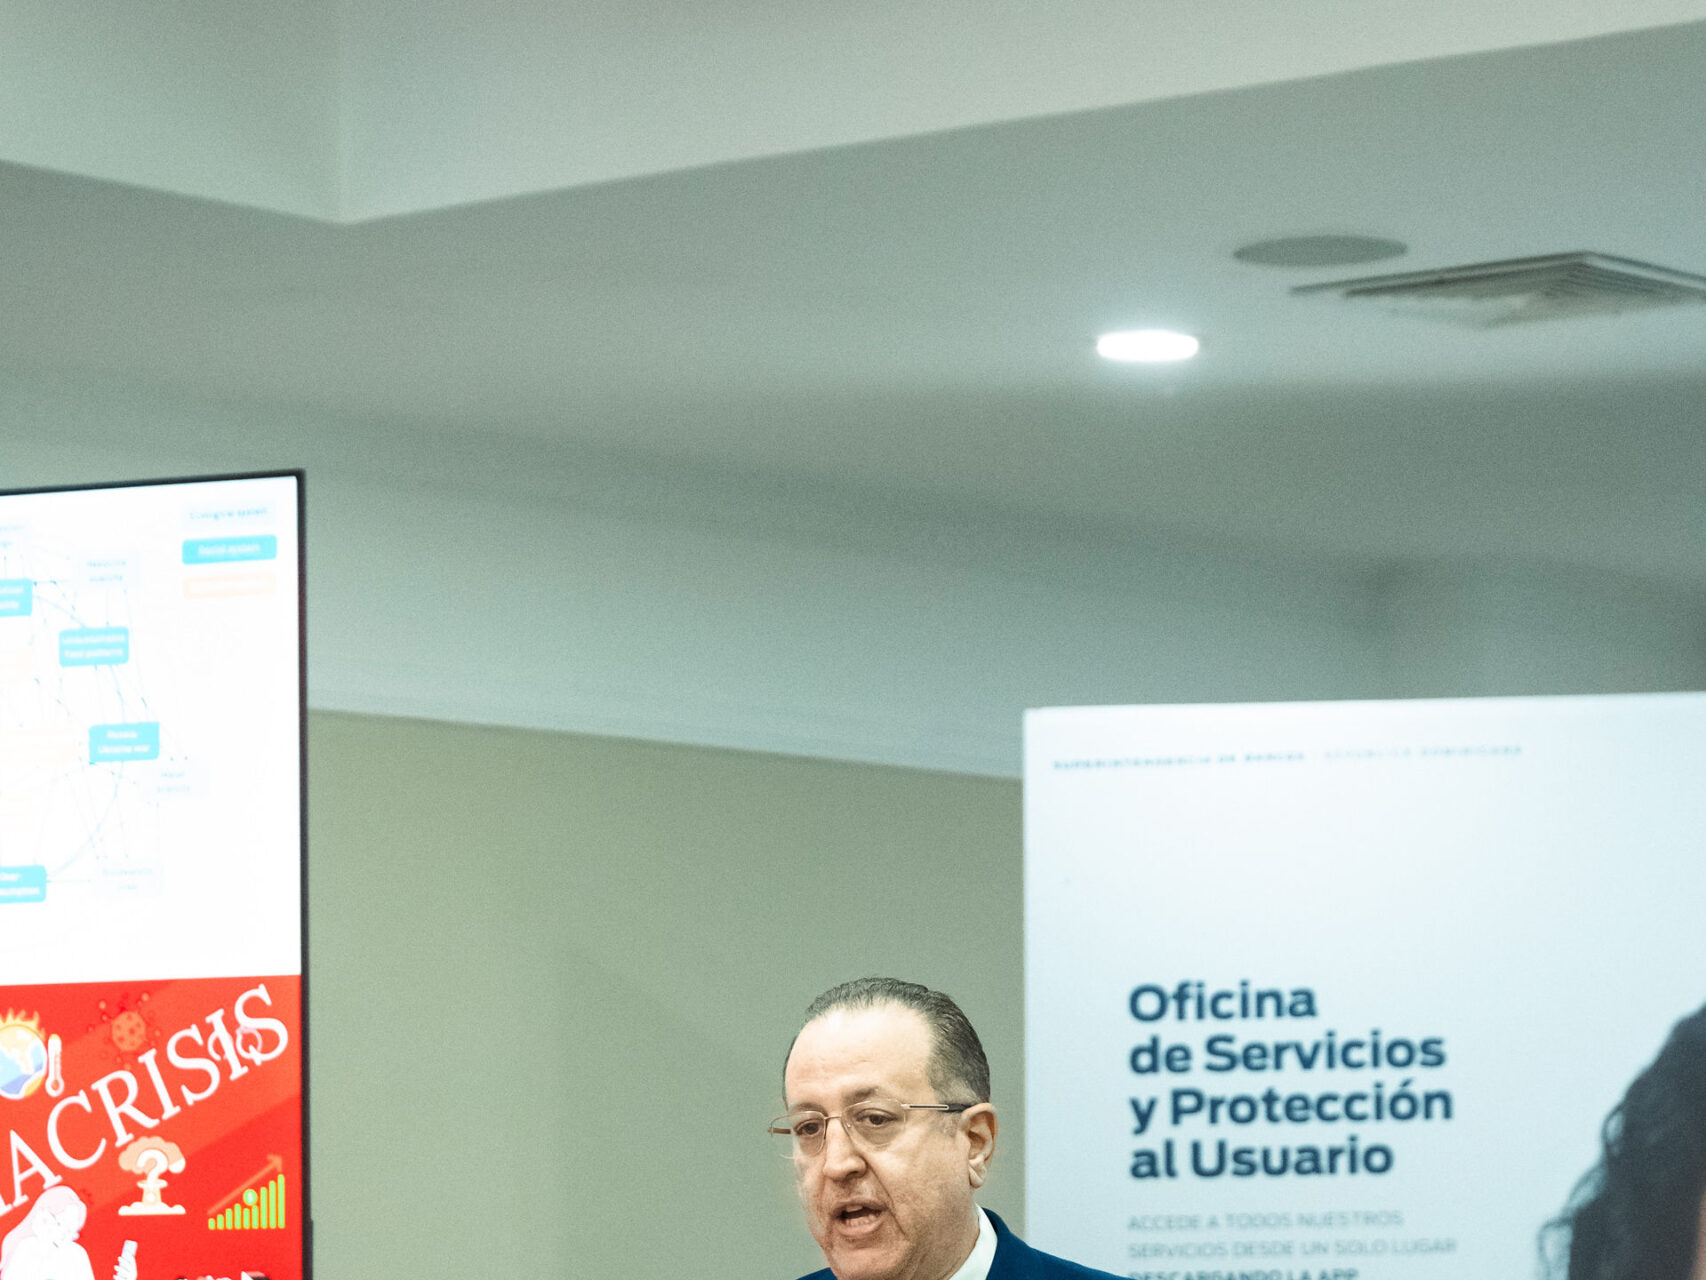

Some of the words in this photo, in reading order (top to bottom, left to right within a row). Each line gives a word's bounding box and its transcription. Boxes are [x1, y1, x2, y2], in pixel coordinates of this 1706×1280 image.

[1129, 979, 1318, 1022] Oficina
[1129, 1033, 1193, 1075] de
[1205, 1028, 1447, 1073] Servicios
[0, 983, 289, 1217] ACRISIS
[1128, 1095, 1158, 1136] y
[1170, 1078, 1453, 1126] Protección
[1129, 1138, 1178, 1179] al
[1190, 1134, 1394, 1178] Usuario
[1127, 1215, 1200, 1231] ACCEDE
[1206, 1214, 1221, 1229] A
[1298, 1210, 1404, 1228] NUESTROS
[1127, 1242, 1228, 1258] SERVICIOS
